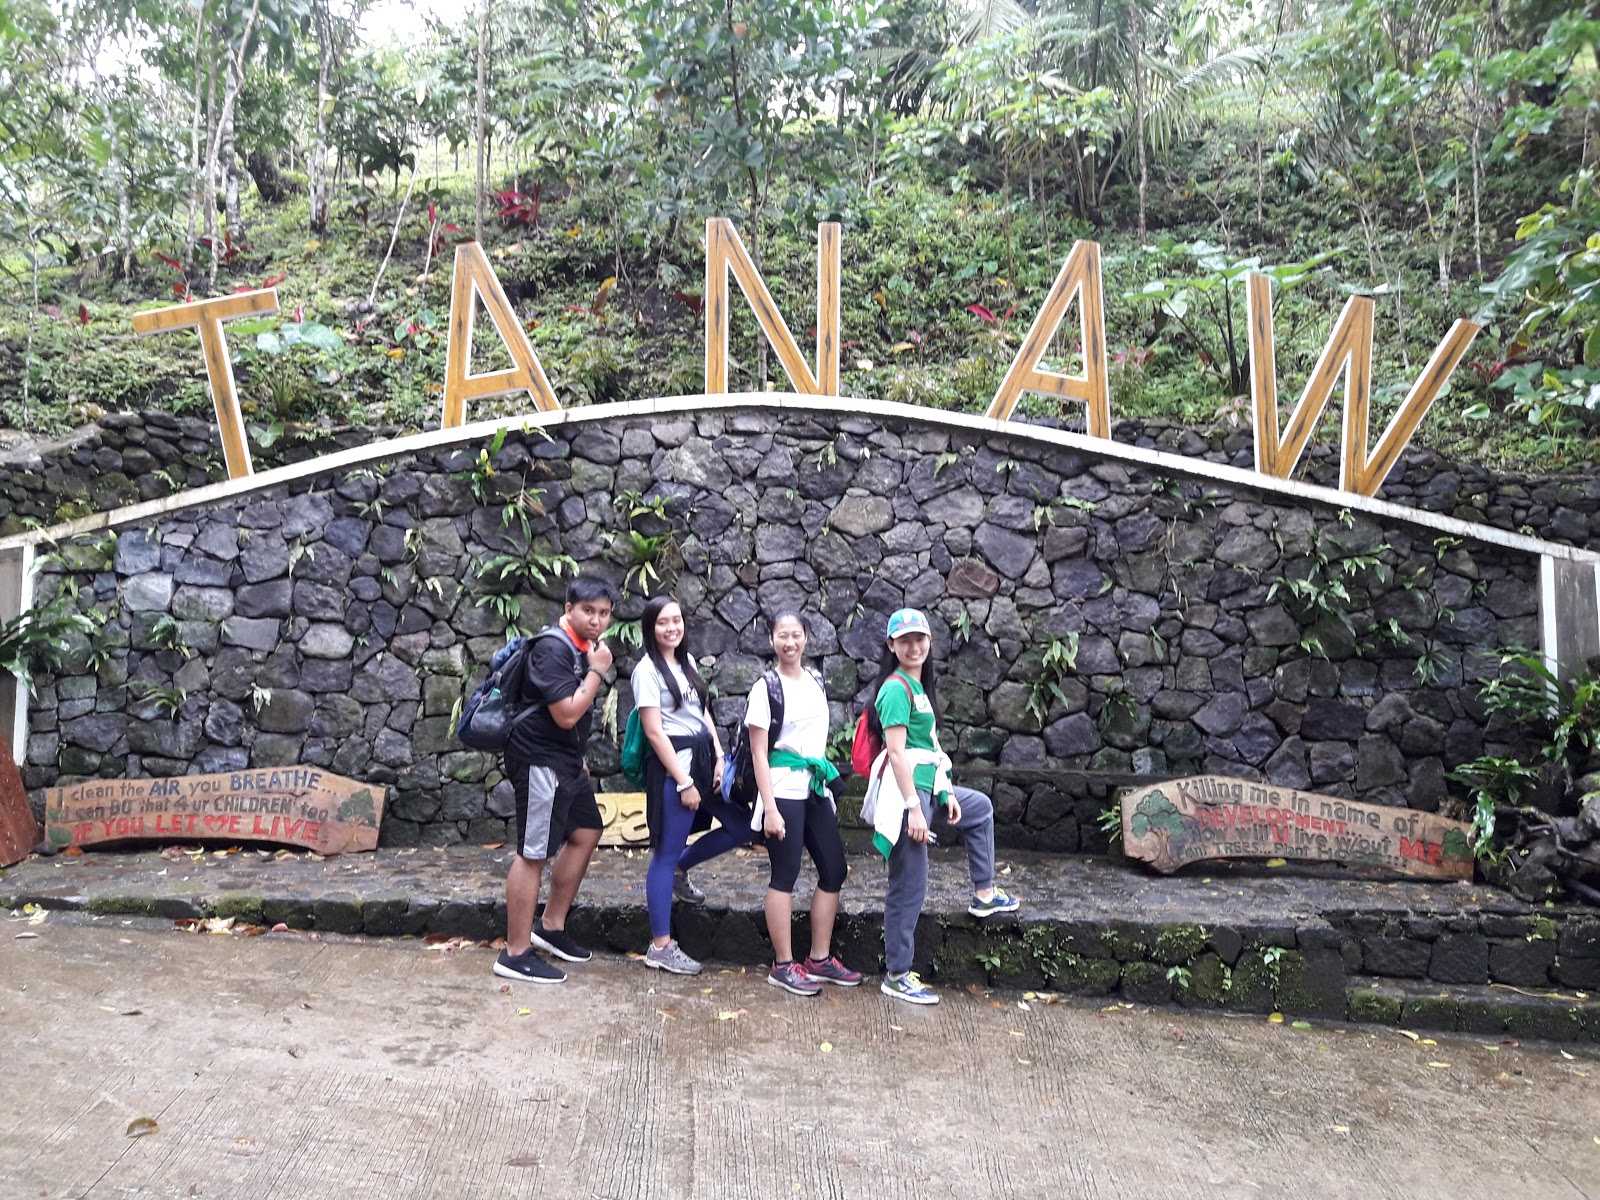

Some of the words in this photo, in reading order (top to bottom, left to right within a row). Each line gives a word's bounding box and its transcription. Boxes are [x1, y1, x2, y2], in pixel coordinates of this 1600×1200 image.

[133, 217, 1480, 499] TANAW
[71, 785, 114, 801] clean
[120, 782, 145, 797] the
[149, 778, 181, 796] AIR
[189, 781, 221, 796] you
[1177, 777, 1243, 811] Killing
[1249, 785, 1282, 806] me
[1291, 791, 1310, 815] in
[1320, 801, 1381, 829] name
[1393, 813, 1420, 837] of
[75, 806, 104, 820] can
[140, 797, 170, 813] that
[174, 795, 189, 812] 4
[193, 798, 211, 812] ur
[301, 802, 329, 821] too
[73, 823, 94, 843] IF
[101, 817, 144, 837] YOU
[155, 814, 200, 833] LET
[1234, 824, 1269, 842] will
[1294, 828, 1328, 848] live
[1400, 836, 1444, 866] ME
